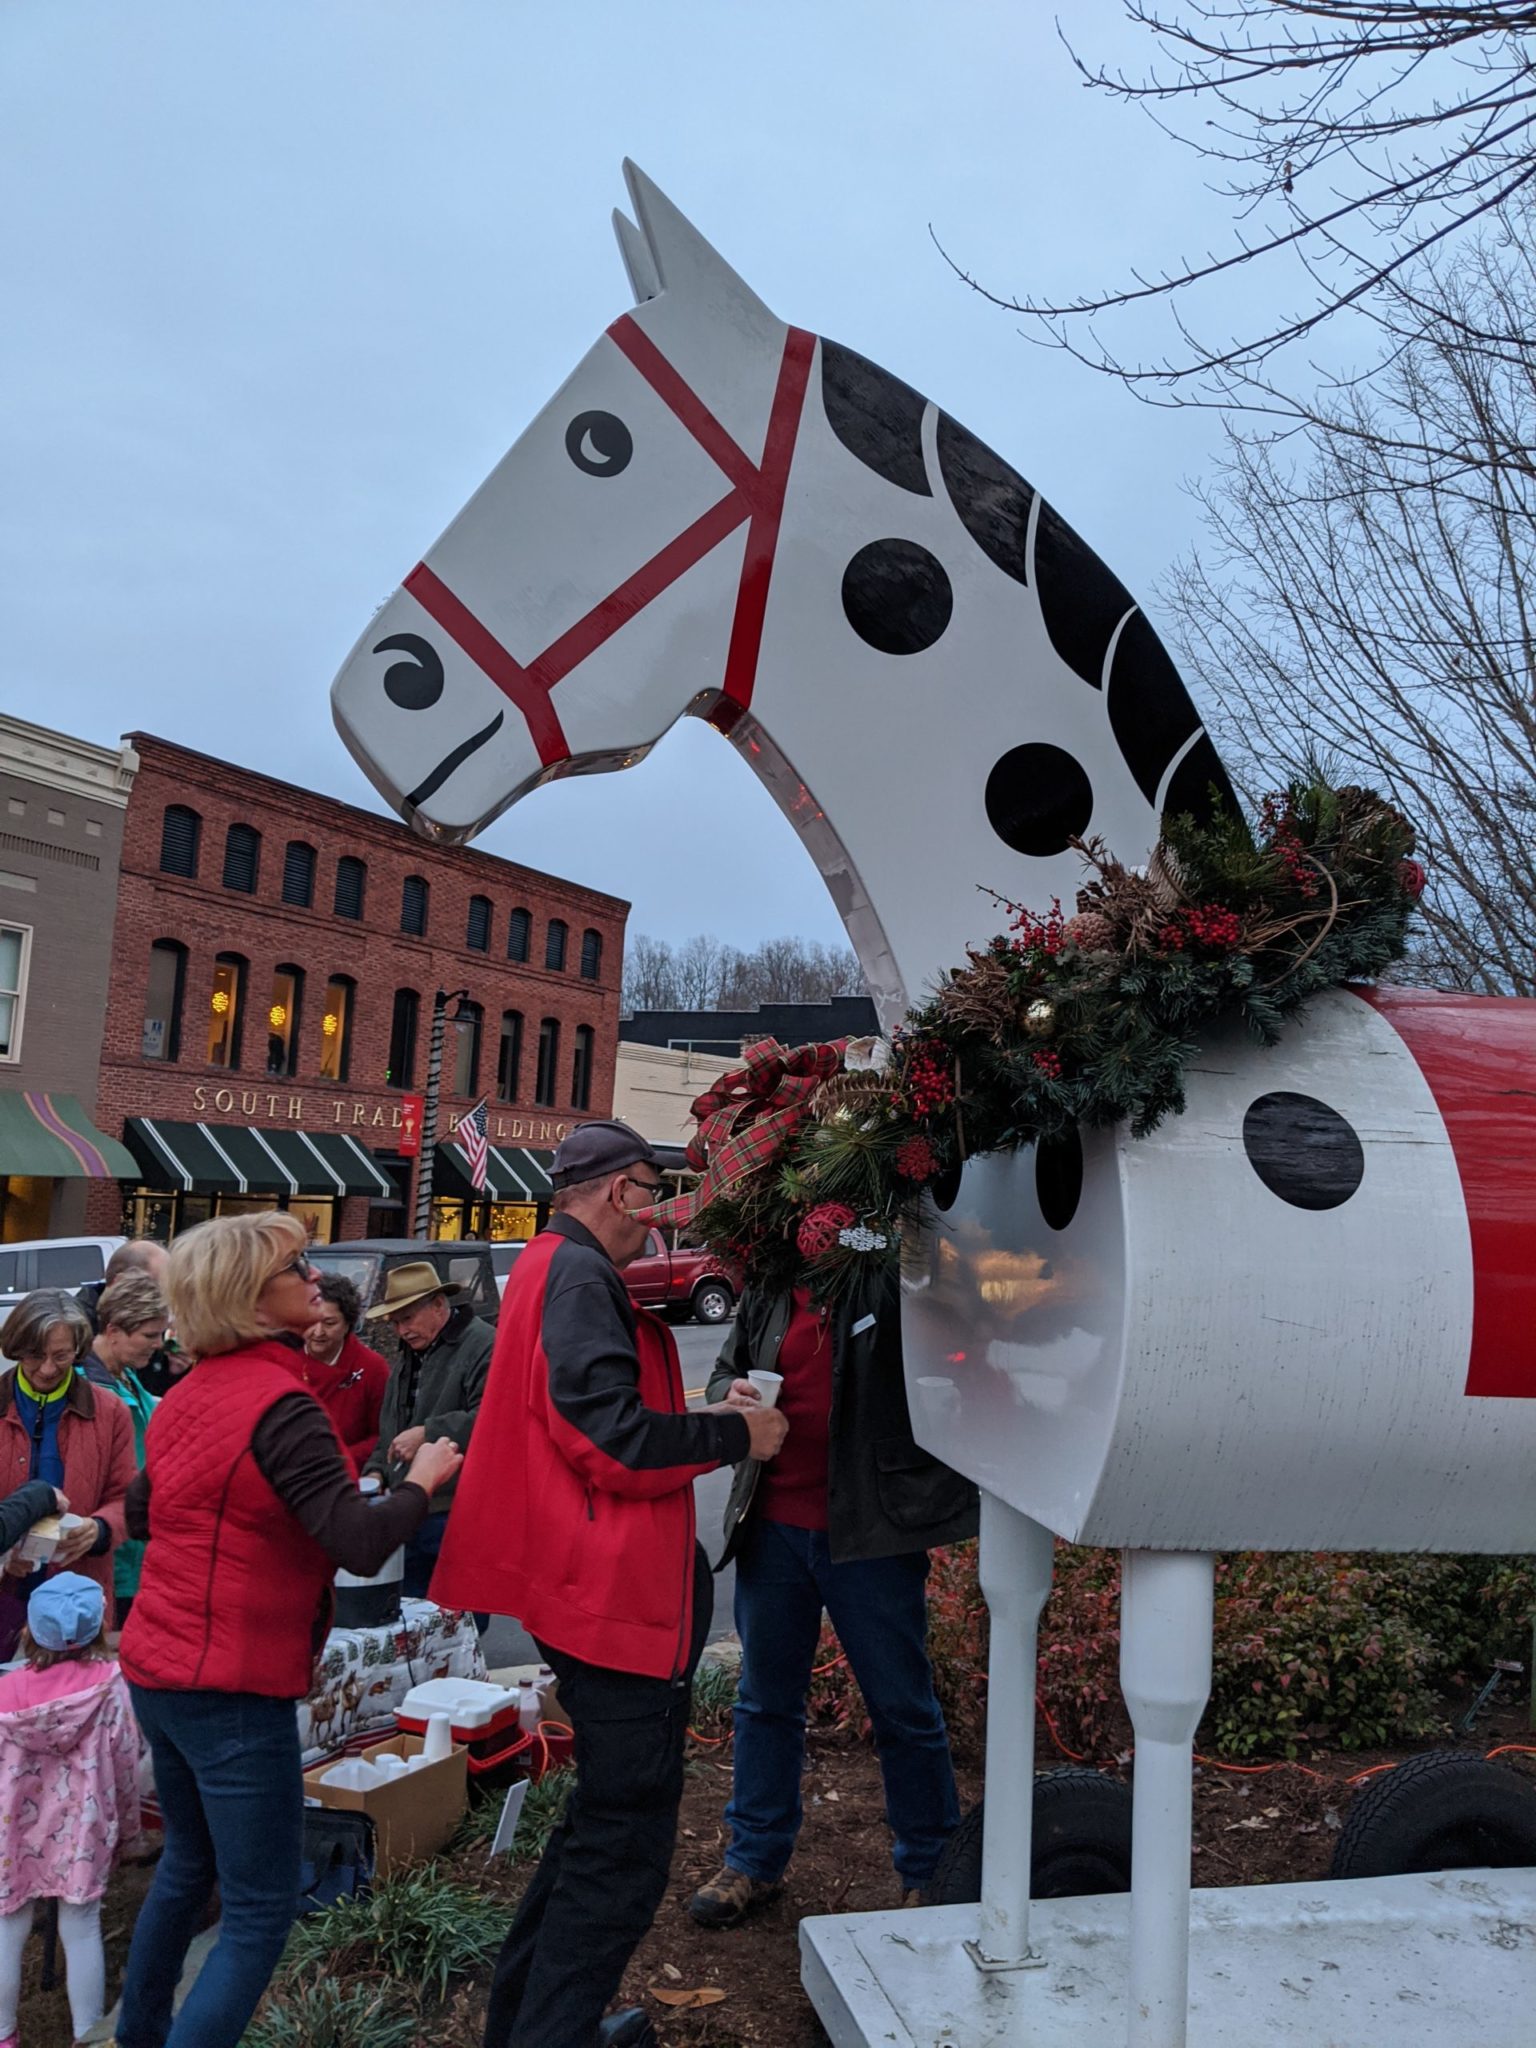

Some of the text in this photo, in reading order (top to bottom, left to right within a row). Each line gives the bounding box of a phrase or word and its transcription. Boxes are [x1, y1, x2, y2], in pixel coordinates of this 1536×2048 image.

[193, 1087, 567, 1141] SOUTH TRAD BLDING
